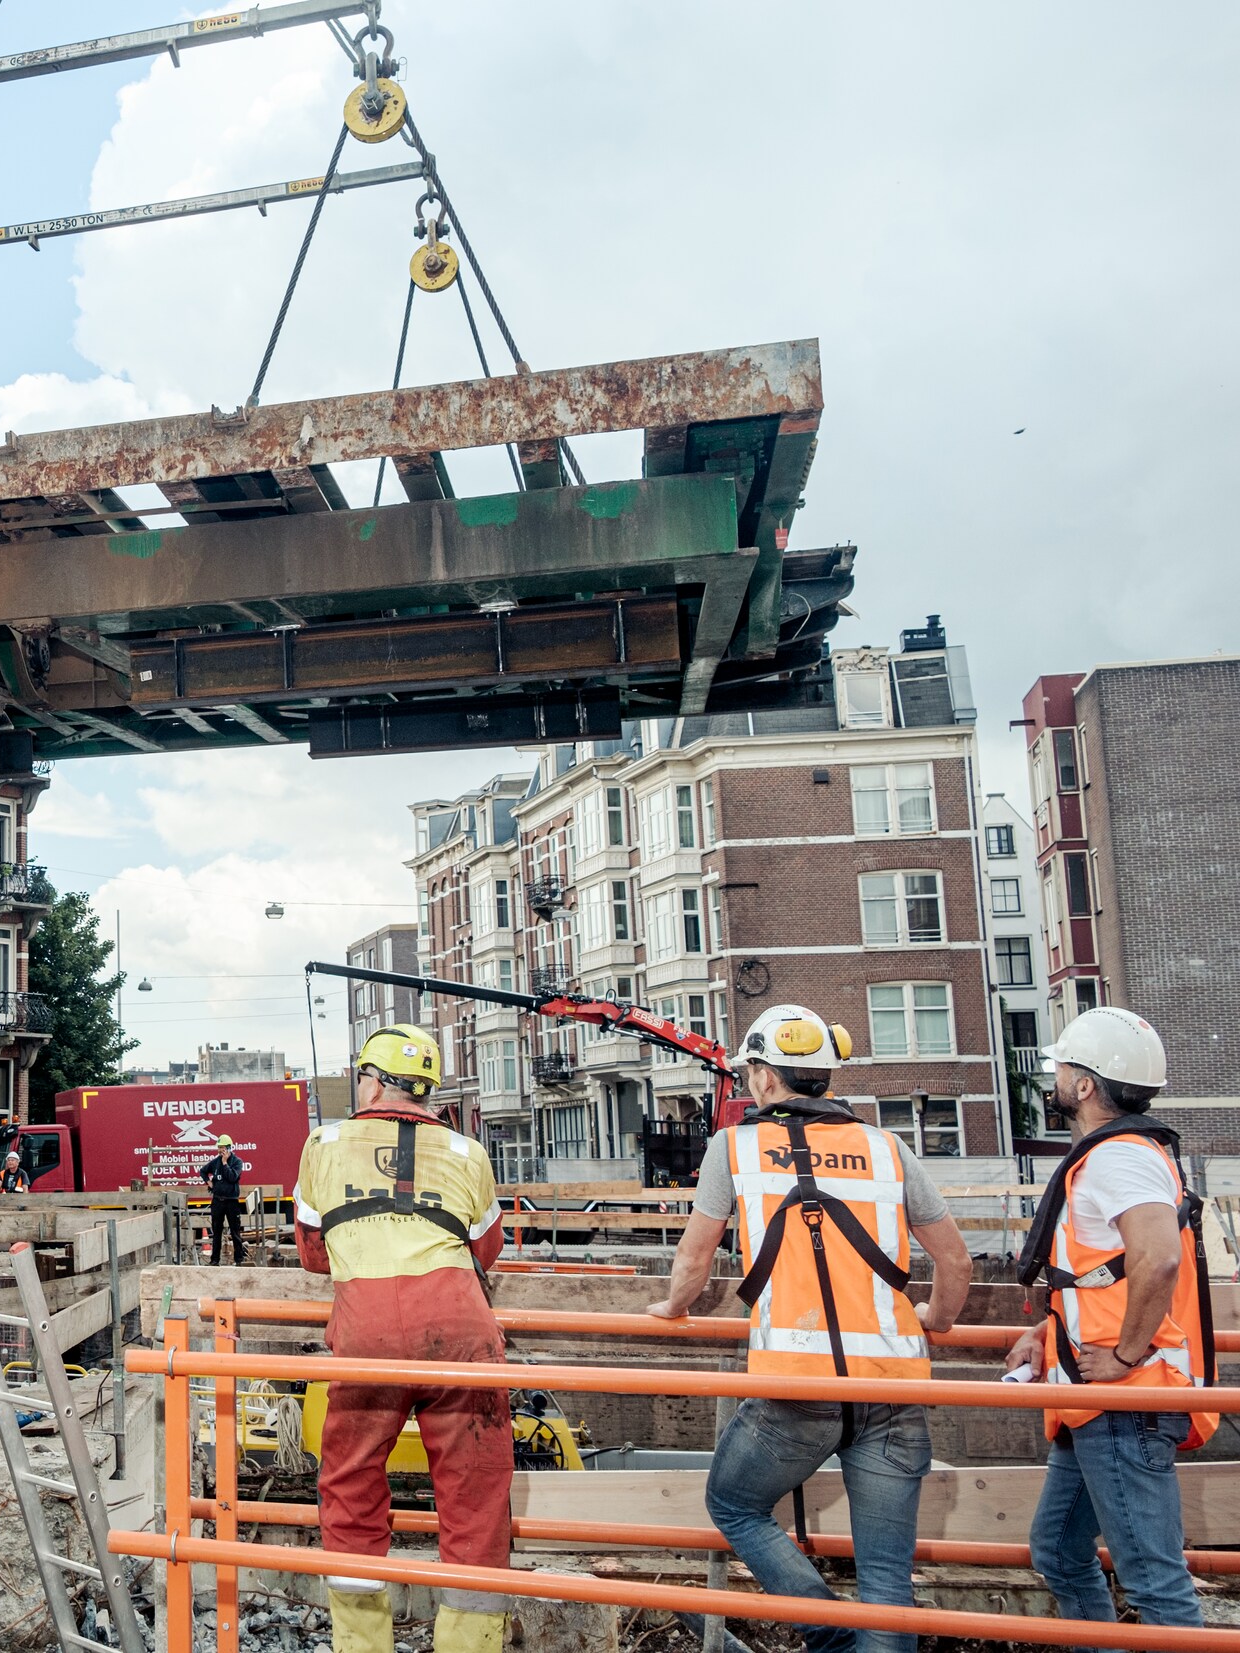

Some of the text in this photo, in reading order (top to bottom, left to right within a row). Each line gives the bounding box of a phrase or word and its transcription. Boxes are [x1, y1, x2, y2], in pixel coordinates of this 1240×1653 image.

[49, 218, 78, 231] 25-50
[81, 214, 104, 226] TON
[633, 1009, 664, 1028] FASSI
[143, 1099, 245, 1117] EVENBOER
[159, 1154, 189, 1163] Mobiel
[142, 1166, 176, 1175] BOEK
[180, 1165, 190, 1174] IN
[345, 1184, 442, 1209] ho
